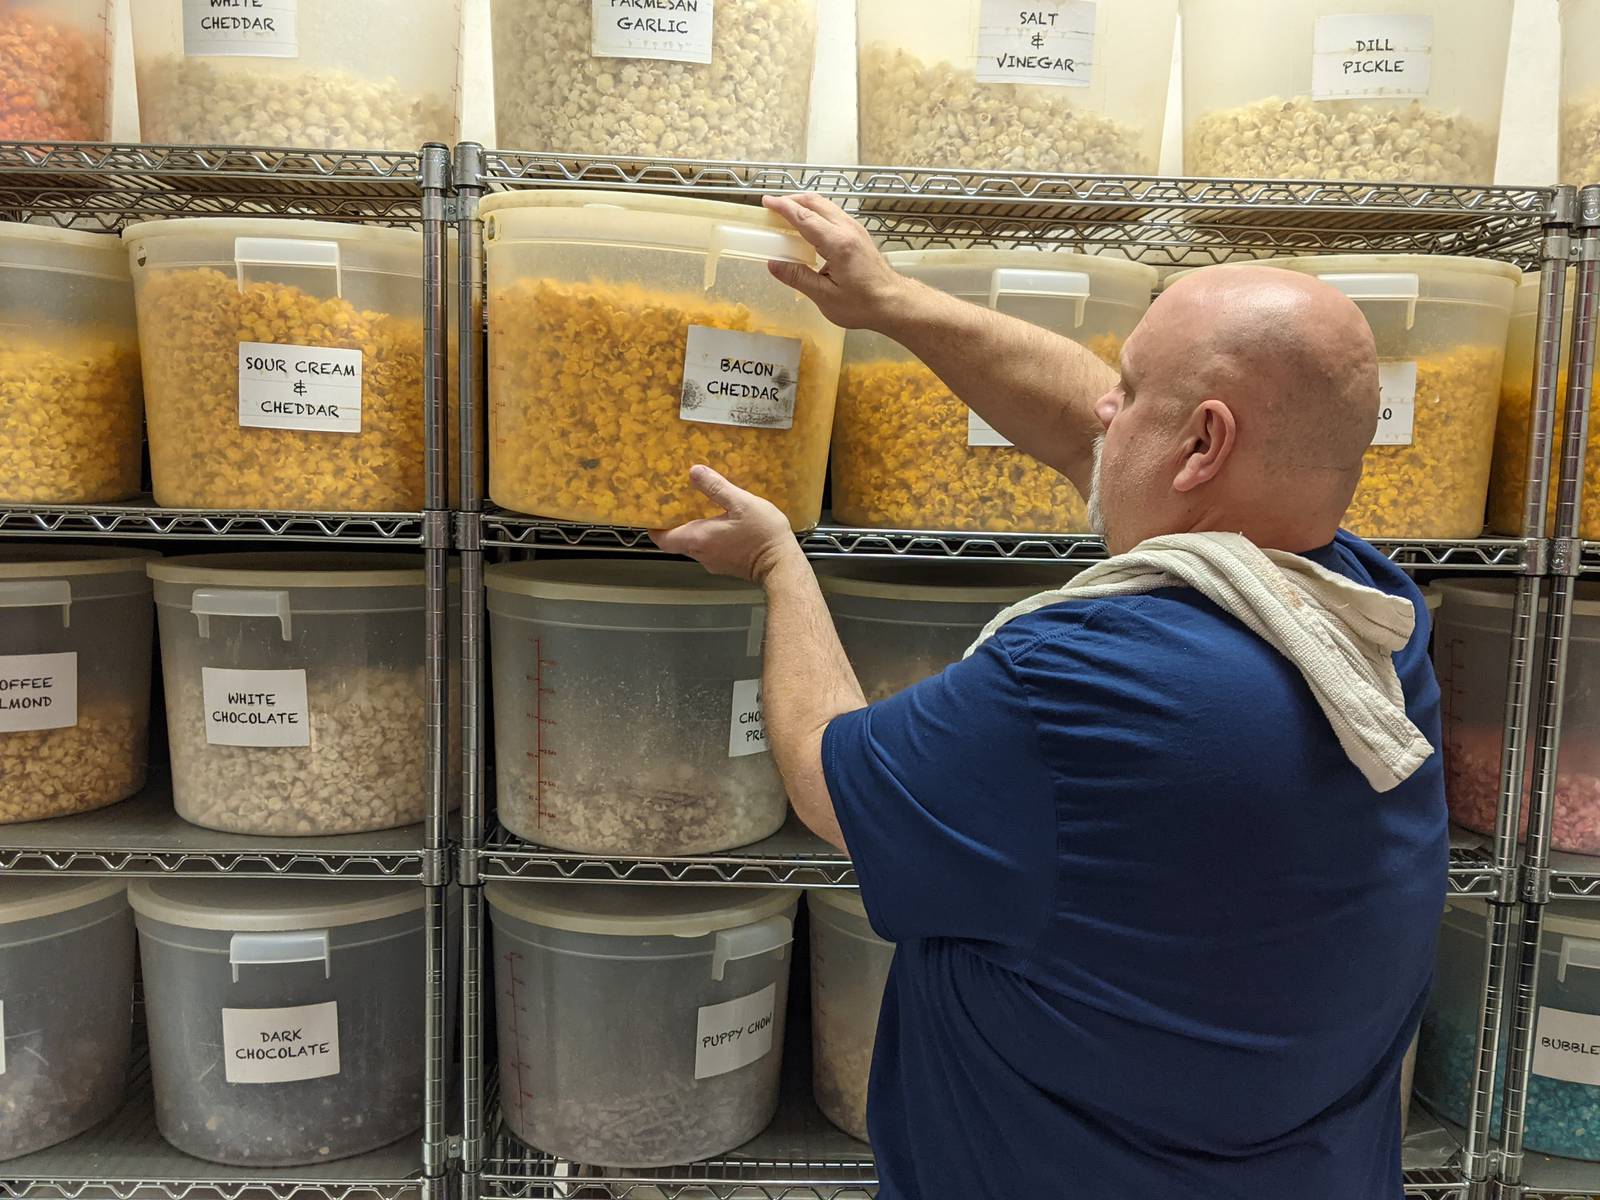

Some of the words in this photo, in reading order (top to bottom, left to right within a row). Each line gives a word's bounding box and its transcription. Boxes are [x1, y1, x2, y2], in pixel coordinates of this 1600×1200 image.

[201, 16, 276, 32] CHEDDAR
[617, 16, 689, 34] GARLIC
[1020, 11, 1059, 26] SALT
[1031, 32, 1045, 50] &
[1356, 38, 1395, 52] DILL
[997, 53, 1075, 73] VINEGAR
[1343, 60, 1405, 75] PICKLE
[246, 357, 288, 374] SOUR
[295, 361, 356, 377] CREAM
[720, 358, 774, 377] BACON
[293, 379, 308, 397] &
[707, 381, 780, 402] CHEDDAR
[261, 400, 340, 418] CHEDDAR
[228, 692, 277, 706] WHITE
[212, 711, 299, 725] CHOCOLATE
[260, 1027, 303, 1043] DARK
[702, 1027, 744, 1049] PUPPY
[747, 1011, 773, 1035] CHOW
[235, 1041, 331, 1060] CHOCOLATE
[1541, 1036, 1600, 1056] BUBBLE
